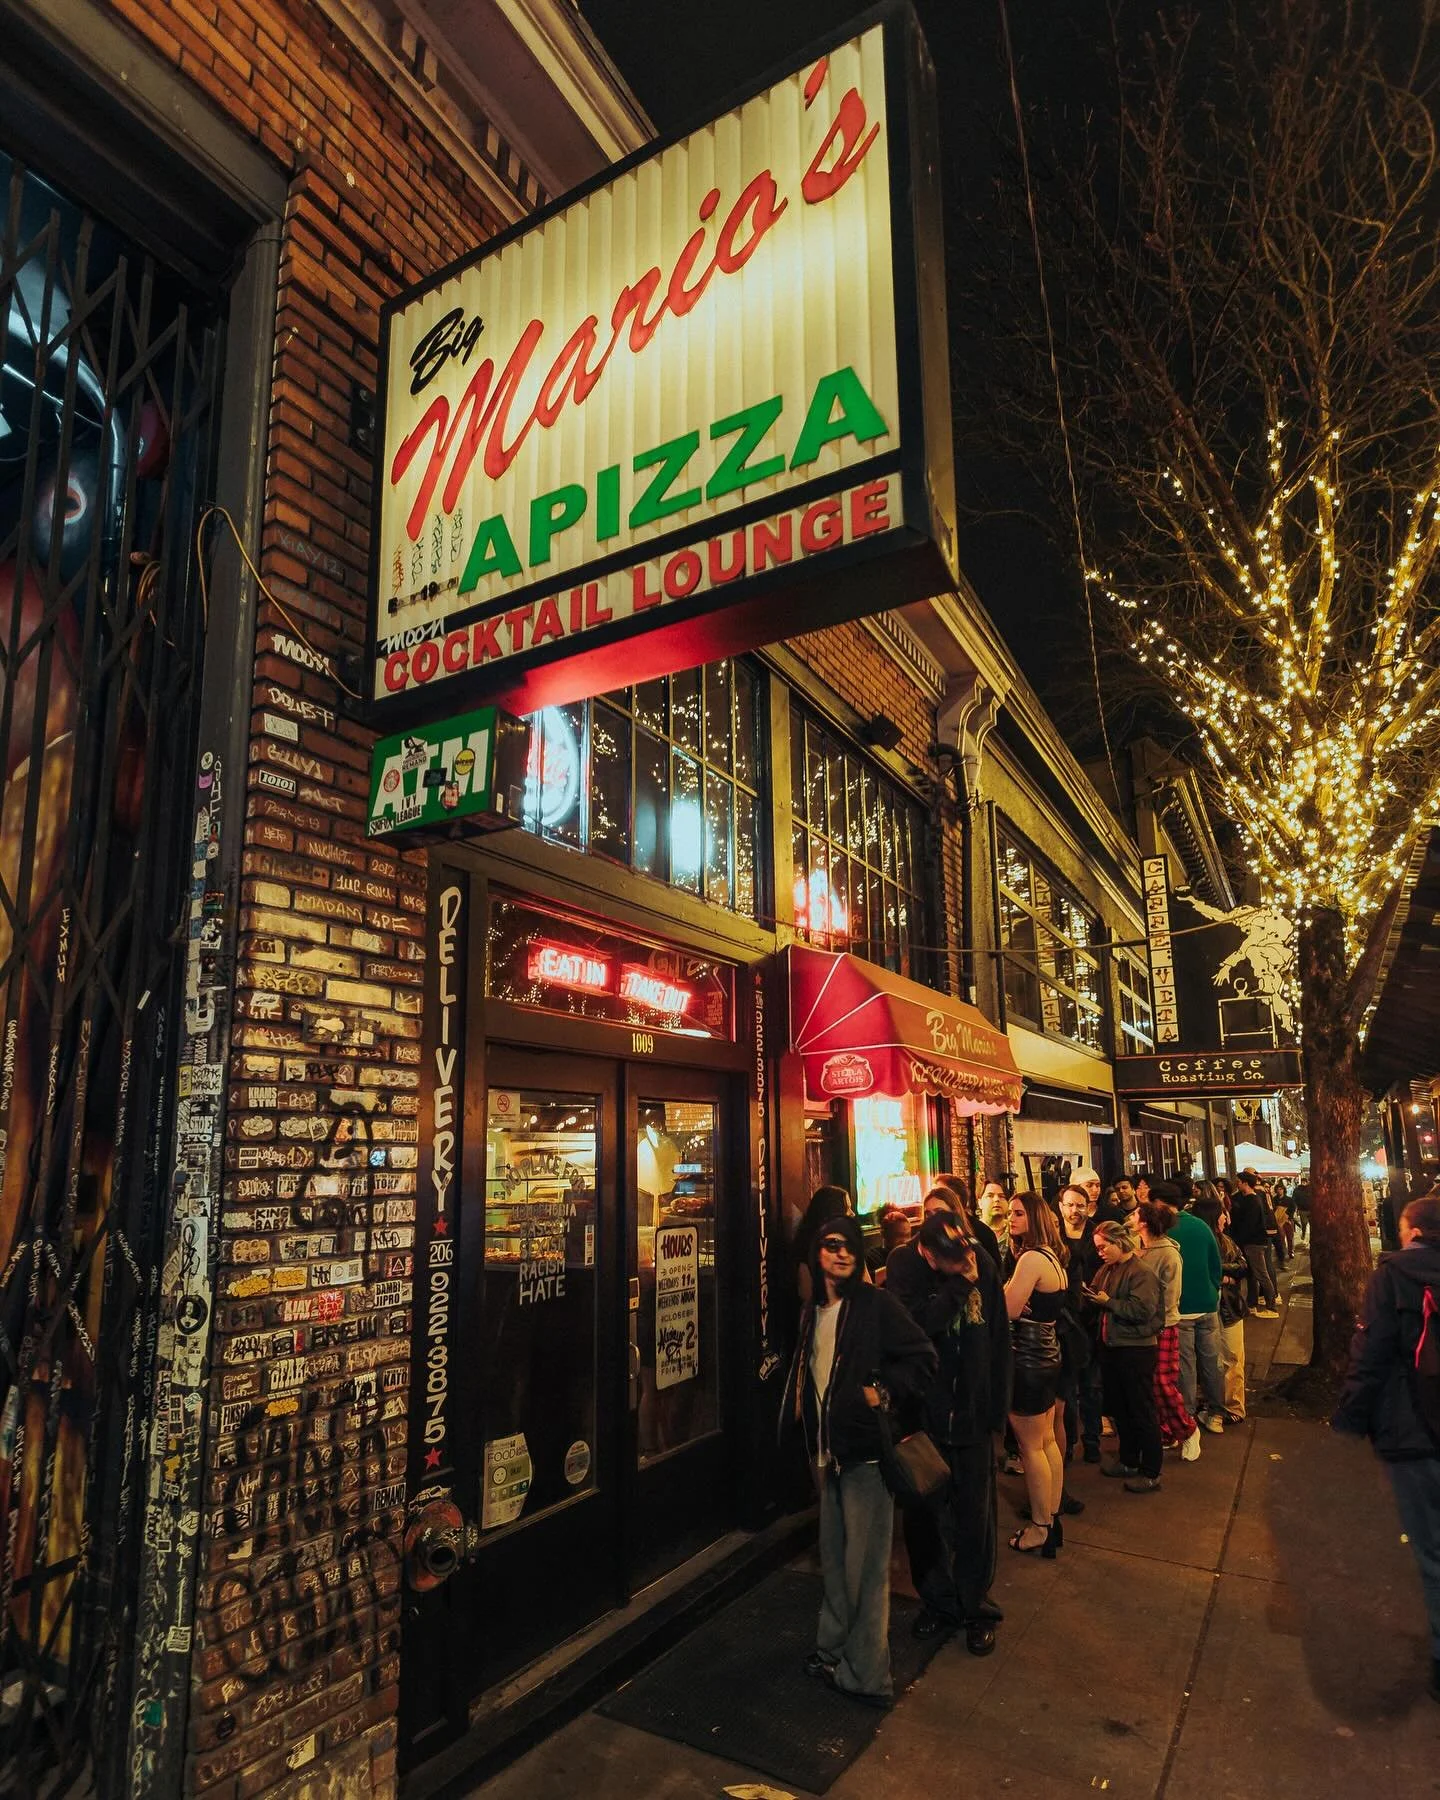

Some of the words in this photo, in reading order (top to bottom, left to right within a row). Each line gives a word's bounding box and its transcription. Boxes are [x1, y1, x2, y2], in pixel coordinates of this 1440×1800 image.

[391, 56, 881, 541] Mario's
[410, 307, 483, 396] Big
[457, 366, 891, 595] APIZZA
[384, 581, 611, 692] COCKTAIL
[632, 480, 893, 607] LOUNGE
[371, 729, 489, 817] ATM
[396, 804, 421, 823] LEAGUE
[540, 949, 585, 984] EAT
[584, 960, 607, 987] IN
[1155, 967, 1178, 1042] VITA
[631, 1033, 654, 1053] 1009
[926, 1010, 959, 1057] Big
[432, 886, 461, 1212] DELIVERY
[831, 1067, 863, 1078] STELLA
[1159, 1058, 1262, 1072] Coffee
[1162, 1071, 1236, 1085] Roasting
[832, 1075, 864, 1086] ARTOIS
[520, 1153, 562, 1179] PLACE
[256, 1208, 289, 1219] KING
[661, 1233, 693, 1260] HOURS
[758, 1138, 768, 1336] DELIVERY
[430, 1243, 453, 1263] 206
[520, 1259, 566, 1282] RACISM
[669, 1264, 687, 1275] OPEN
[681, 1273, 691, 1287] 11
[376, 1281, 401, 1295] BAMBI
[376, 1293, 400, 1307] JIPRO
[519, 1275, 566, 1306] HATE
[685, 1320, 695, 1350] 2
